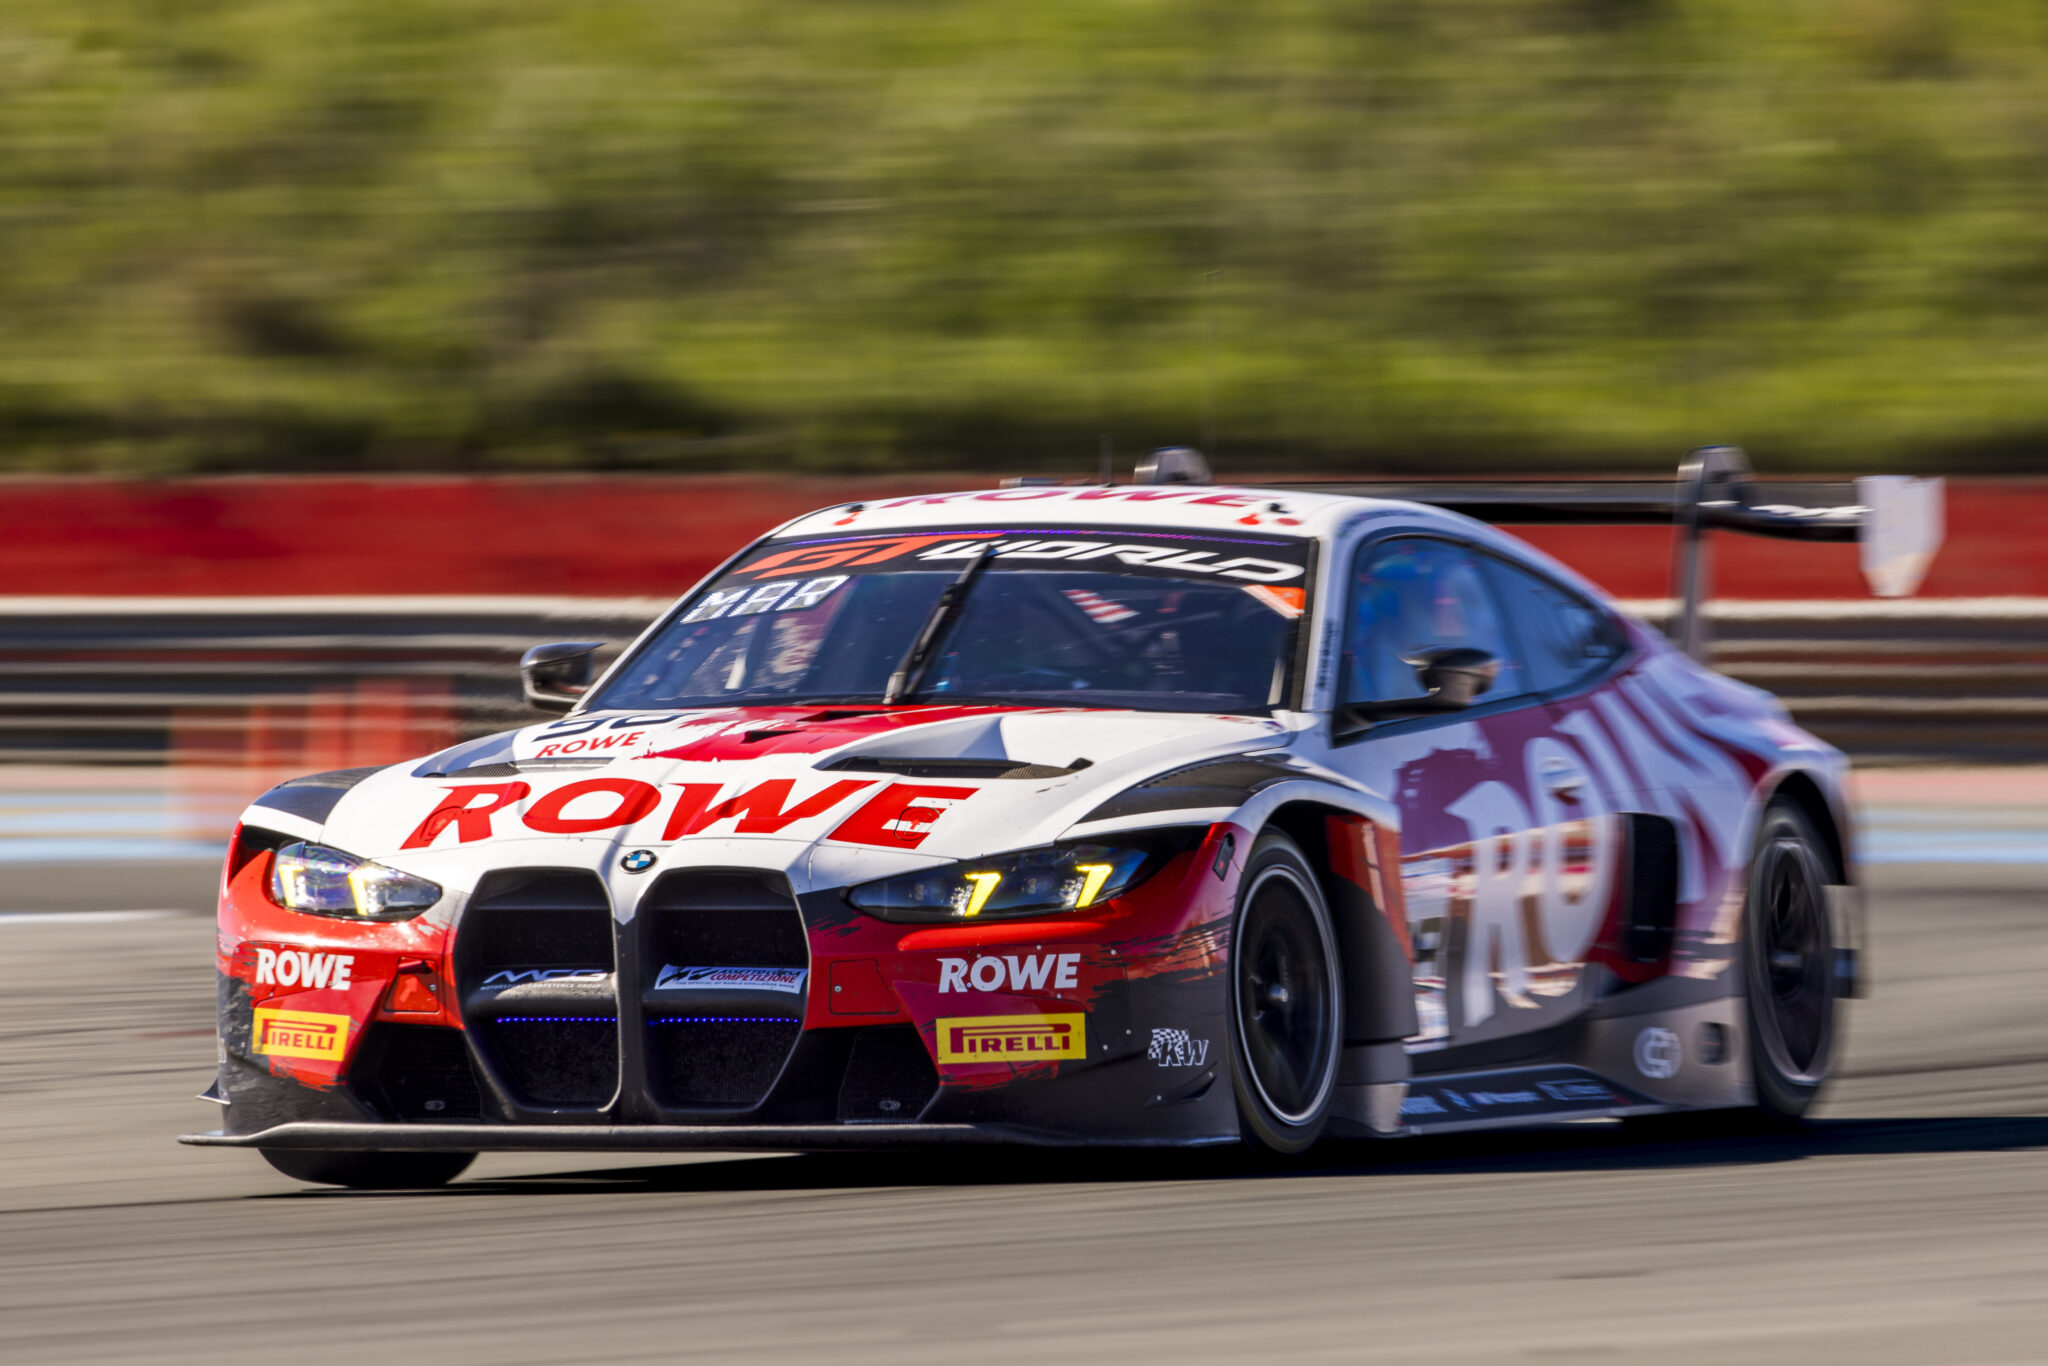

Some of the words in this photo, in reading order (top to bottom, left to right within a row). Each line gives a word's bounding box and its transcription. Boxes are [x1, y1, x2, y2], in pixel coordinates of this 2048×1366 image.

[735, 533, 1004, 578] GT
[916, 540, 1305, 582] WORLD
[534, 731, 645, 758] ROWE
[400, 778, 980, 849] ROWE
[255, 948, 354, 990] ROWE
[710, 973, 798, 984] COMPETIZIONE
[937, 953, 1081, 993] ROWE
[262, 1018, 337, 1051] PIRELLI
[949, 1023, 1071, 1054] PIRELLI
[1158, 1039, 1209, 1067] KW
